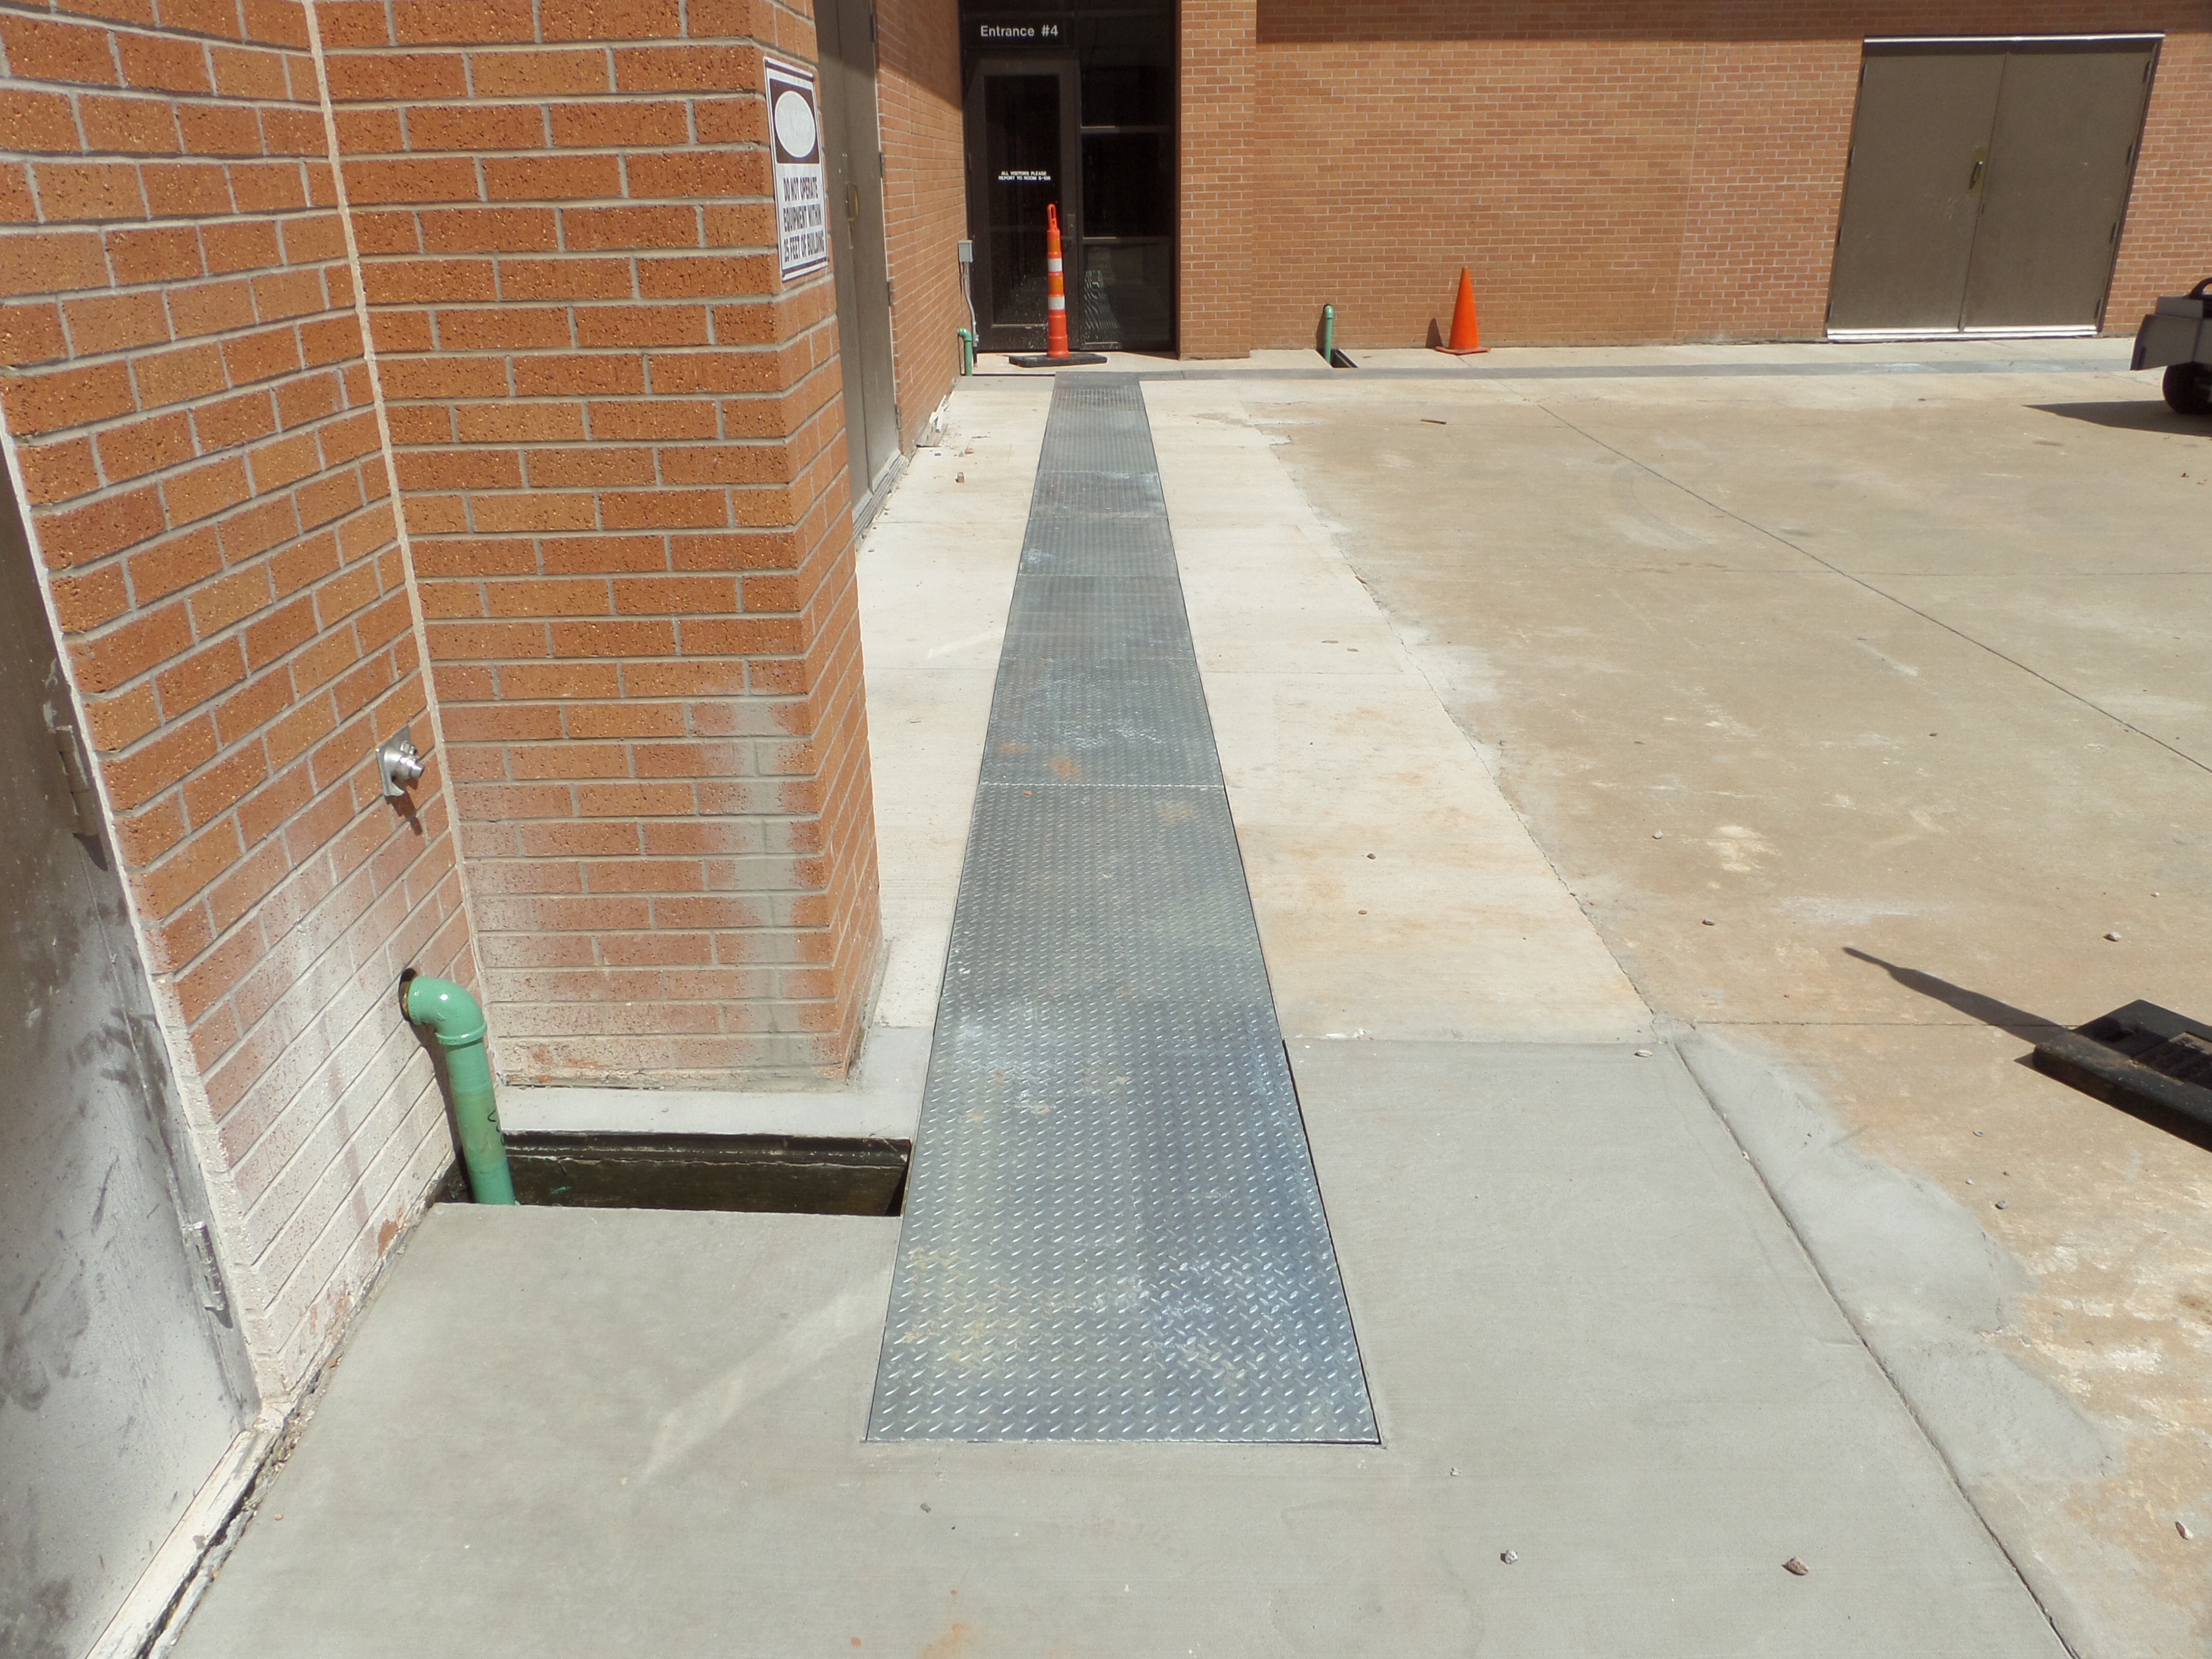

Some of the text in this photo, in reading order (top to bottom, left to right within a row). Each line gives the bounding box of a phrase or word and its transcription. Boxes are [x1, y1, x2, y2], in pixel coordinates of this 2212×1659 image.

[981, 25, 1059, 37] Entrance #4
[783, 176, 818, 202] DO NOT OPERATE
[783, 204, 822, 232] EQUIPMENT WITHIN
[784, 229, 825, 262] 25 FEET OF BUILDING
